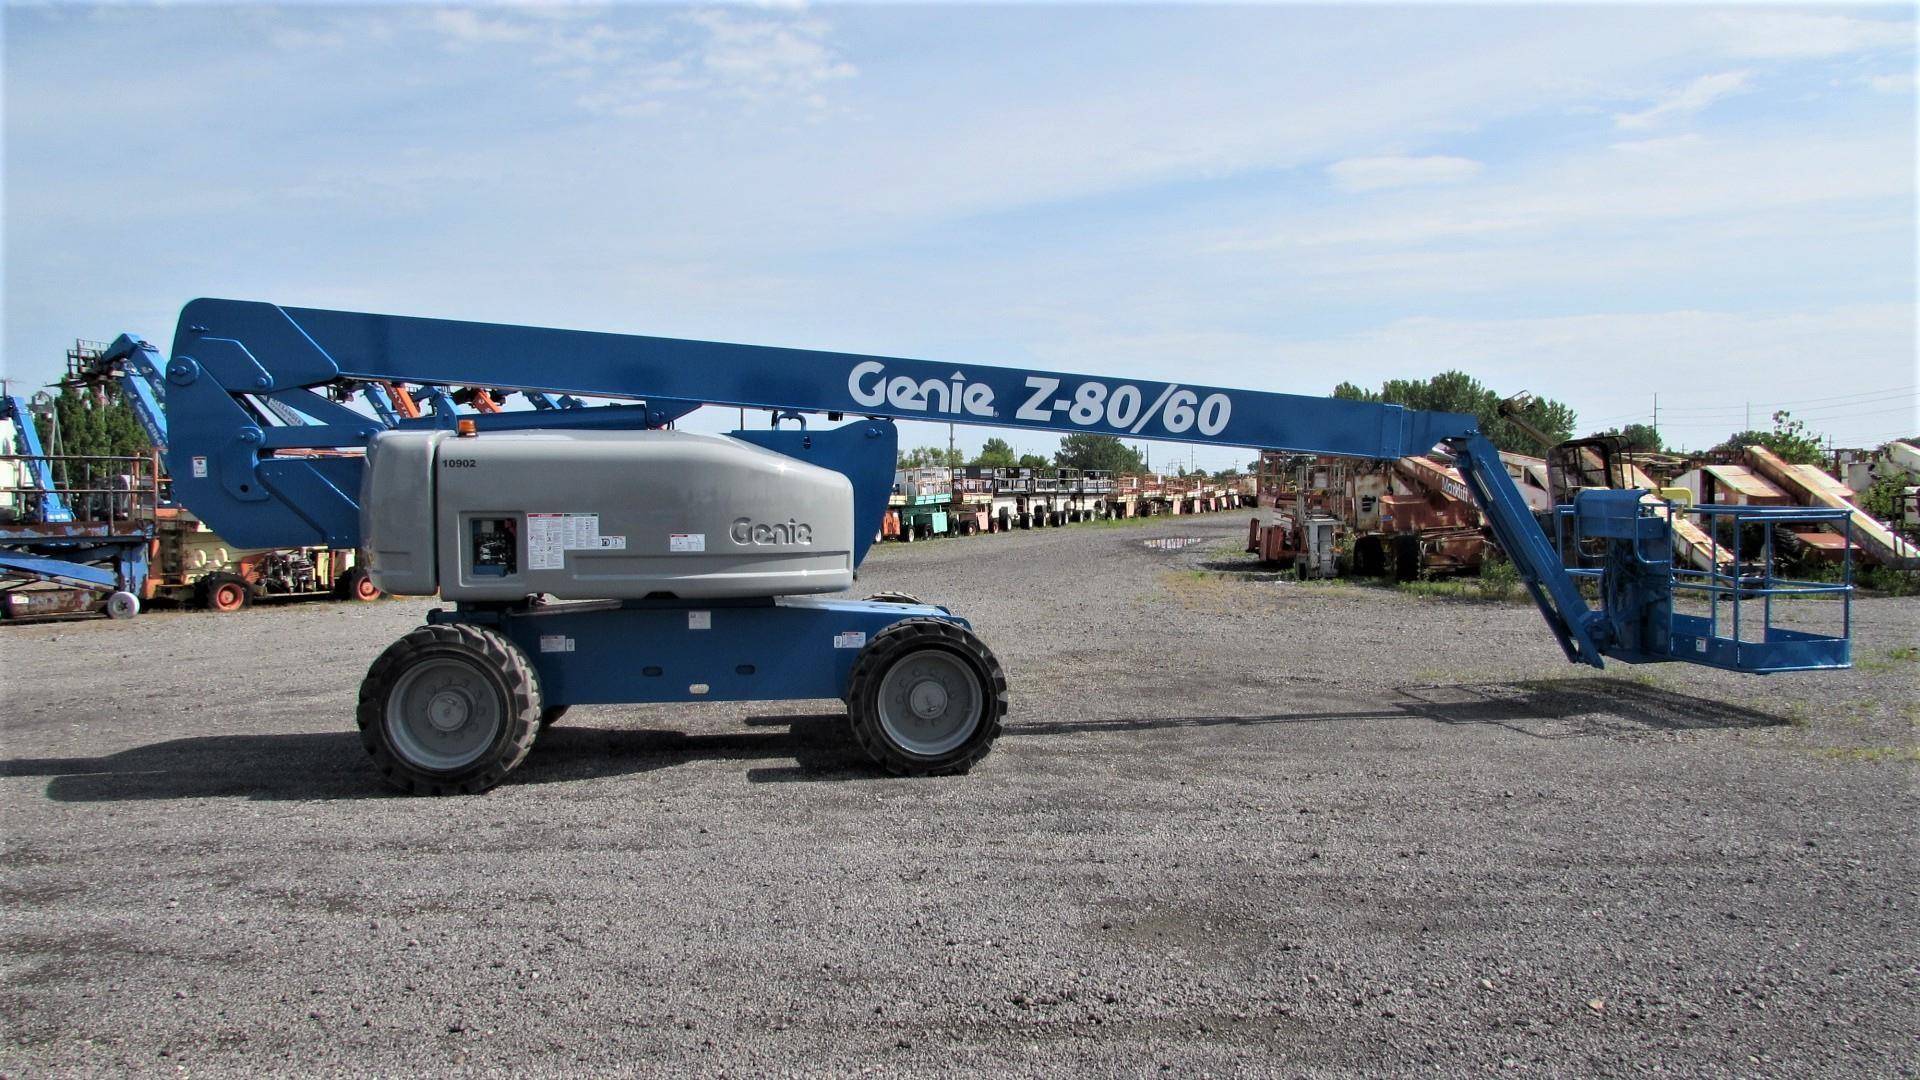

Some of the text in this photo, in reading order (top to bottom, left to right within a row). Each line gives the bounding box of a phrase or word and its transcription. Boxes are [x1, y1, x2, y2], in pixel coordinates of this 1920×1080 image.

[848, 361, 1232, 436] Genie Z-80/60
[442, 459, 477, 468] 10902
[730, 517, 812, 546] Genie
